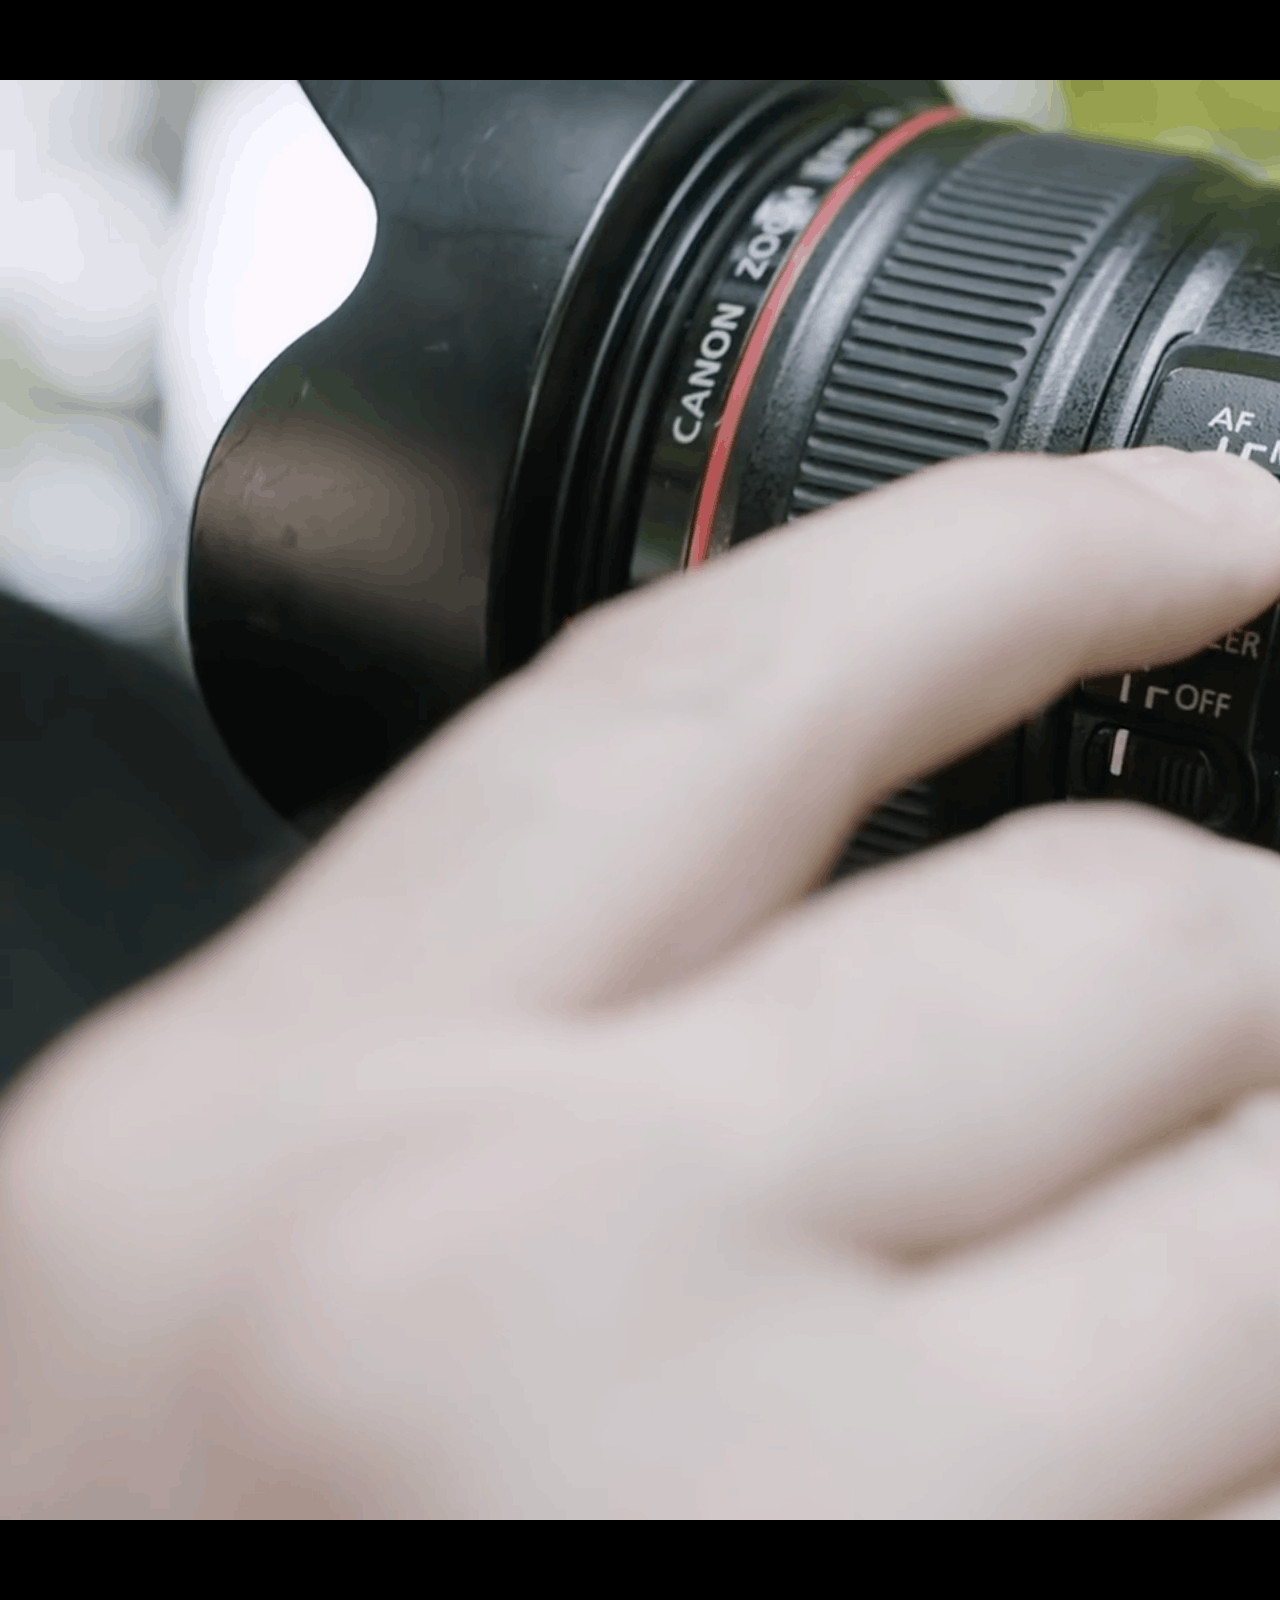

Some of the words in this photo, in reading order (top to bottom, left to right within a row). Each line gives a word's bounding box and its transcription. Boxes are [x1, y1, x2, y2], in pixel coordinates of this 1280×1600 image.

[672, 303, 746, 444] CANON
[1208, 406, 1255, 434] AF
[1174, 683, 1232, 718] OFF
